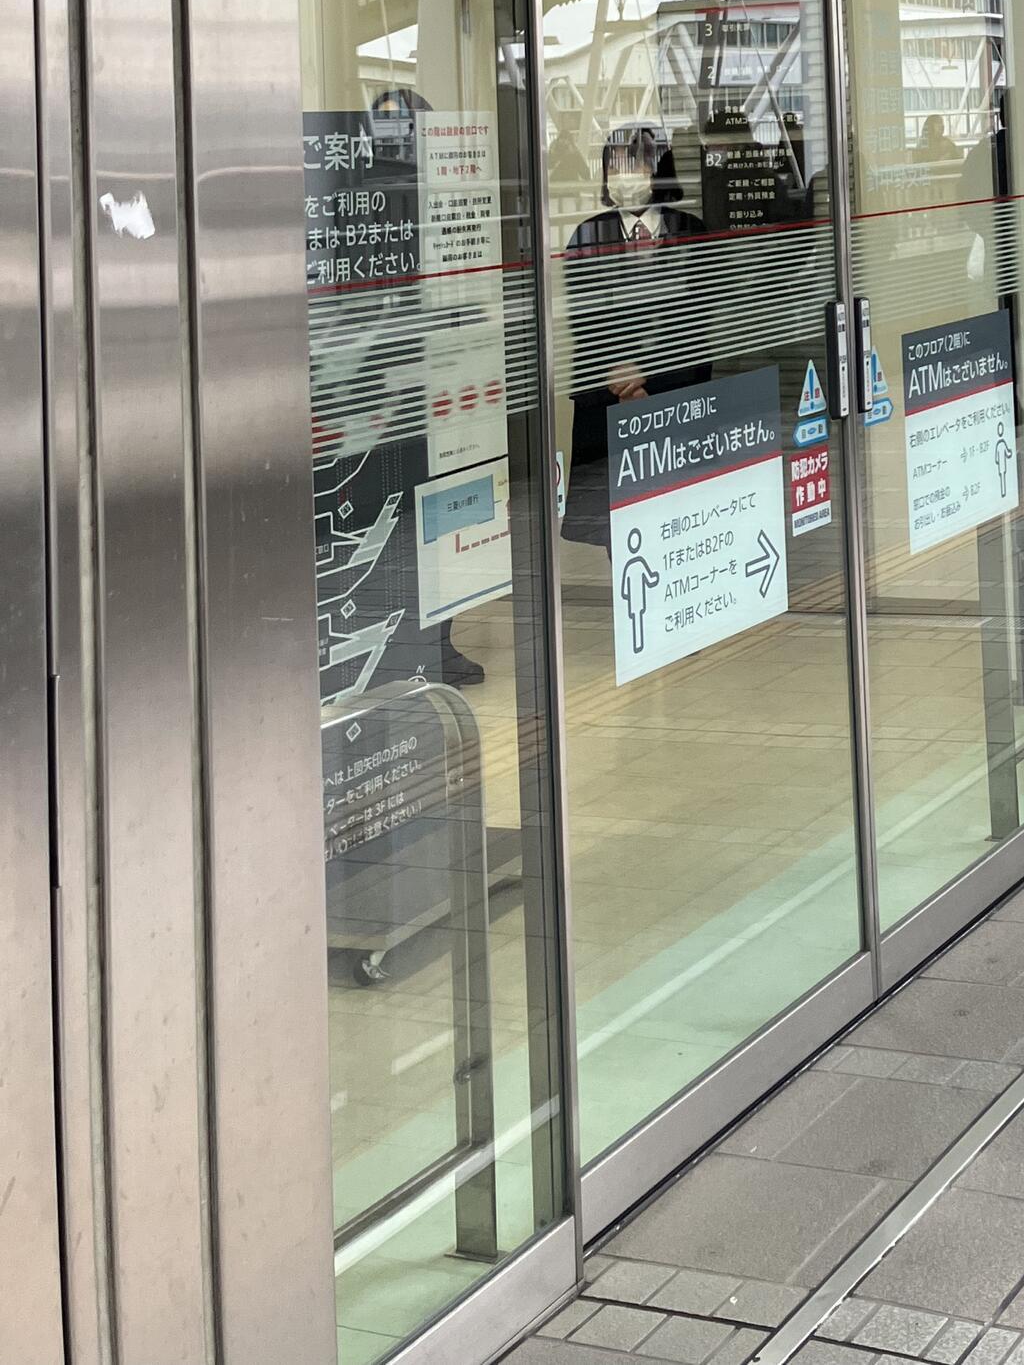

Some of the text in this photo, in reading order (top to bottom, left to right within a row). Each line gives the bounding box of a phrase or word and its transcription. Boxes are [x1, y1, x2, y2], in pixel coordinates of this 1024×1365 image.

[706, 153, 722, 168] B2
[305, 190, 386, 219] をご利用の
[908, 352, 1009, 399] ATMはございません。
[616, 419, 776, 488] ATMはございません。
[791, 451, 829, 482] 防犯カメラ
[795, 477, 827, 507] 作動中
[660, 491, 757, 542] 右側のエレベータにて
[662, 530, 735, 572] 1FまたはB2Fの
[664, 559, 738, 603] ATMコーナーを
[664, 590, 737, 633] ご利用ください。
